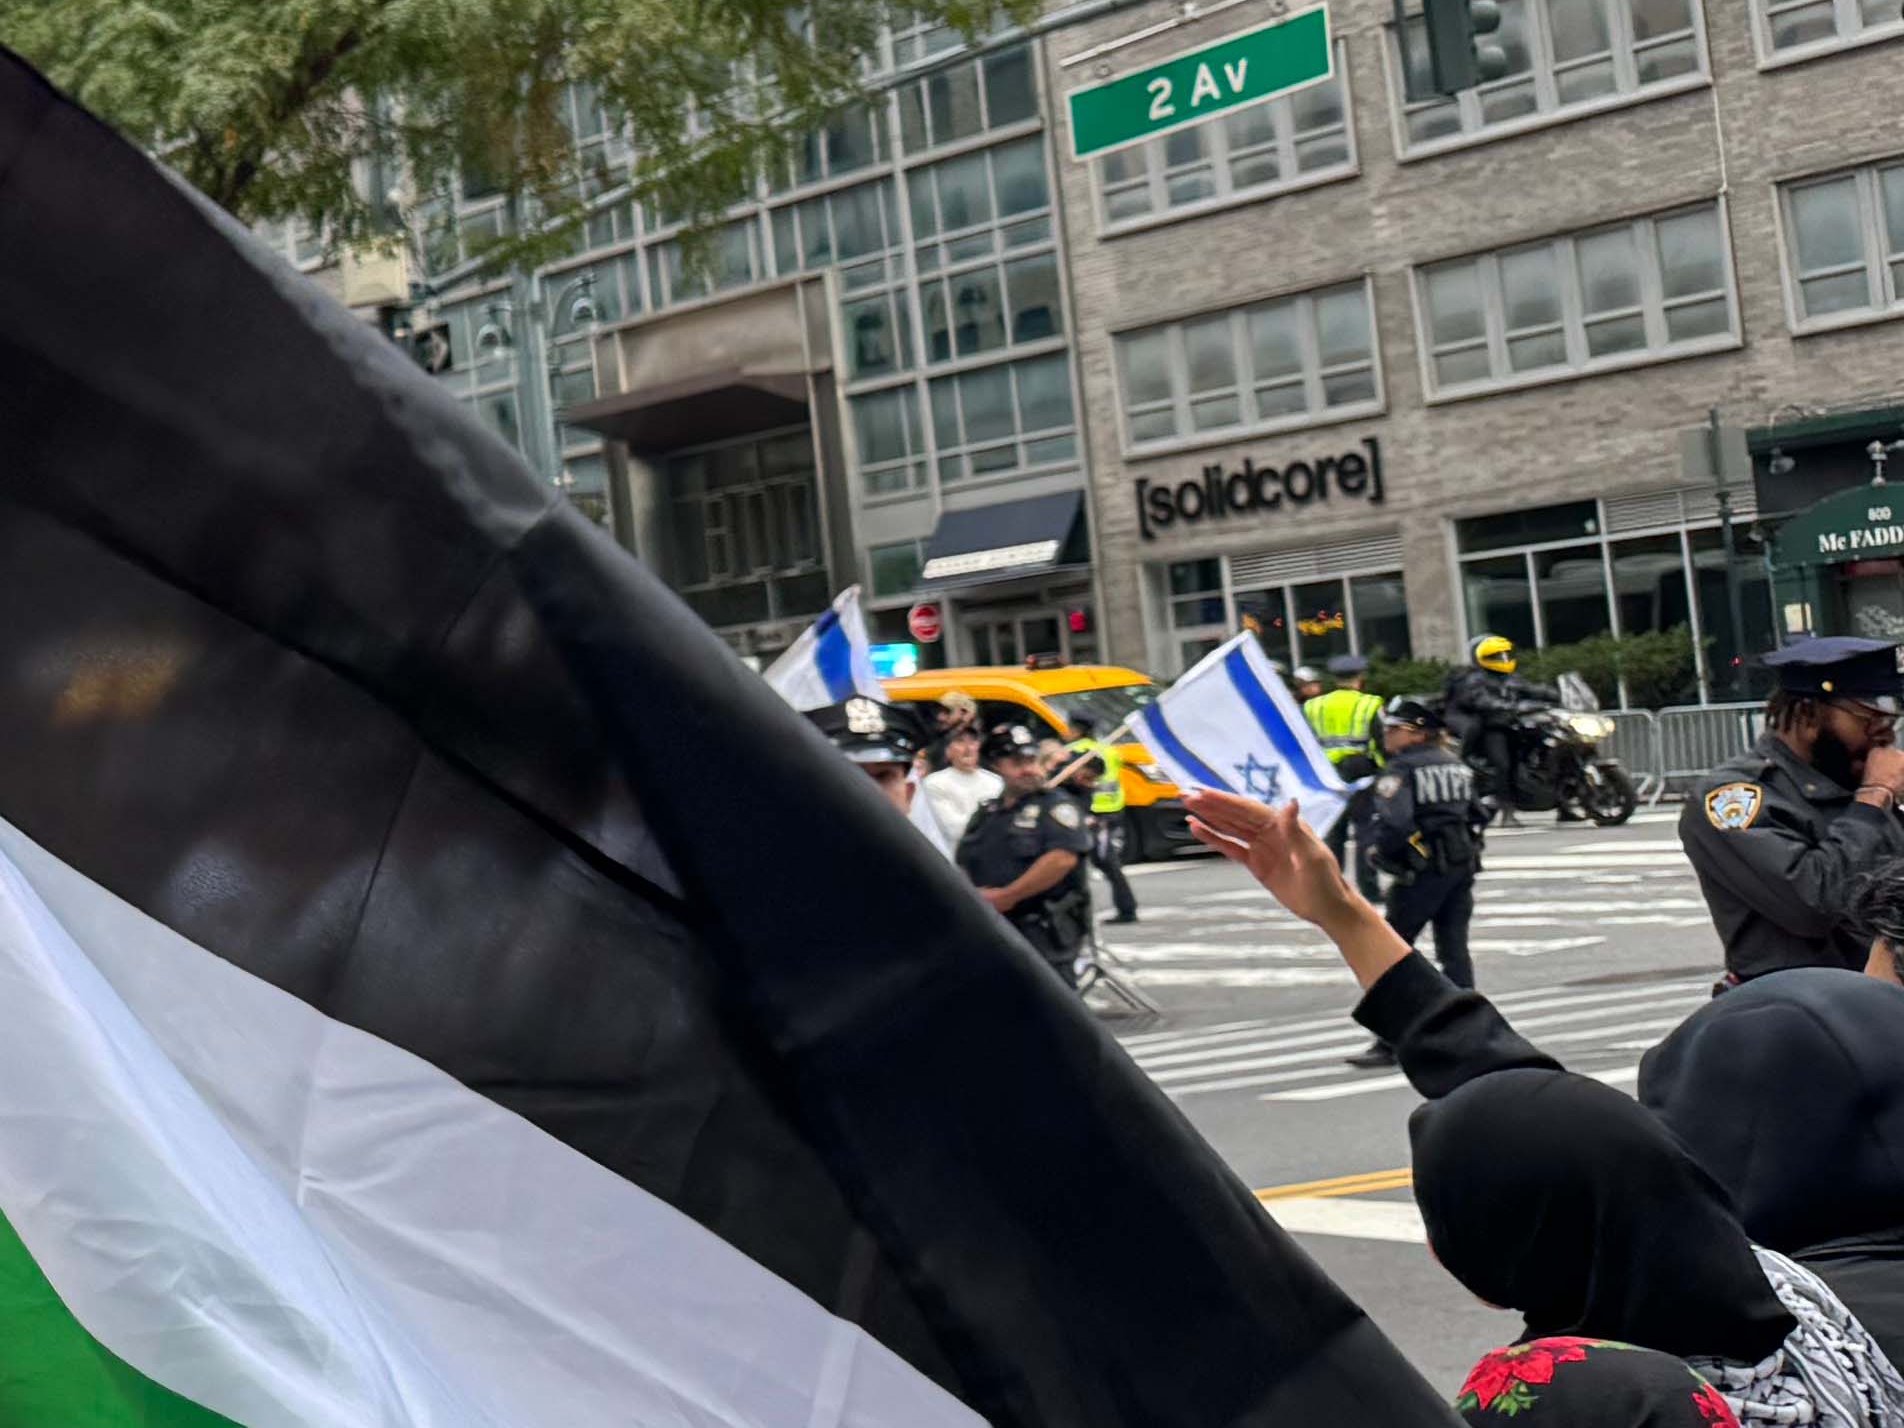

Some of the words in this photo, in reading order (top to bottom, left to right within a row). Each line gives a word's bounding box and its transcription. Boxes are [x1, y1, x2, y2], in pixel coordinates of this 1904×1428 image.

[1147, 77, 1175, 120] 2
[1190, 58, 1248, 108] Av
[1135, 436, 1384, 540] [solidcore]
[1818, 533, 1847, 553] Mc
[1850, 525, 1904, 549] FADD
